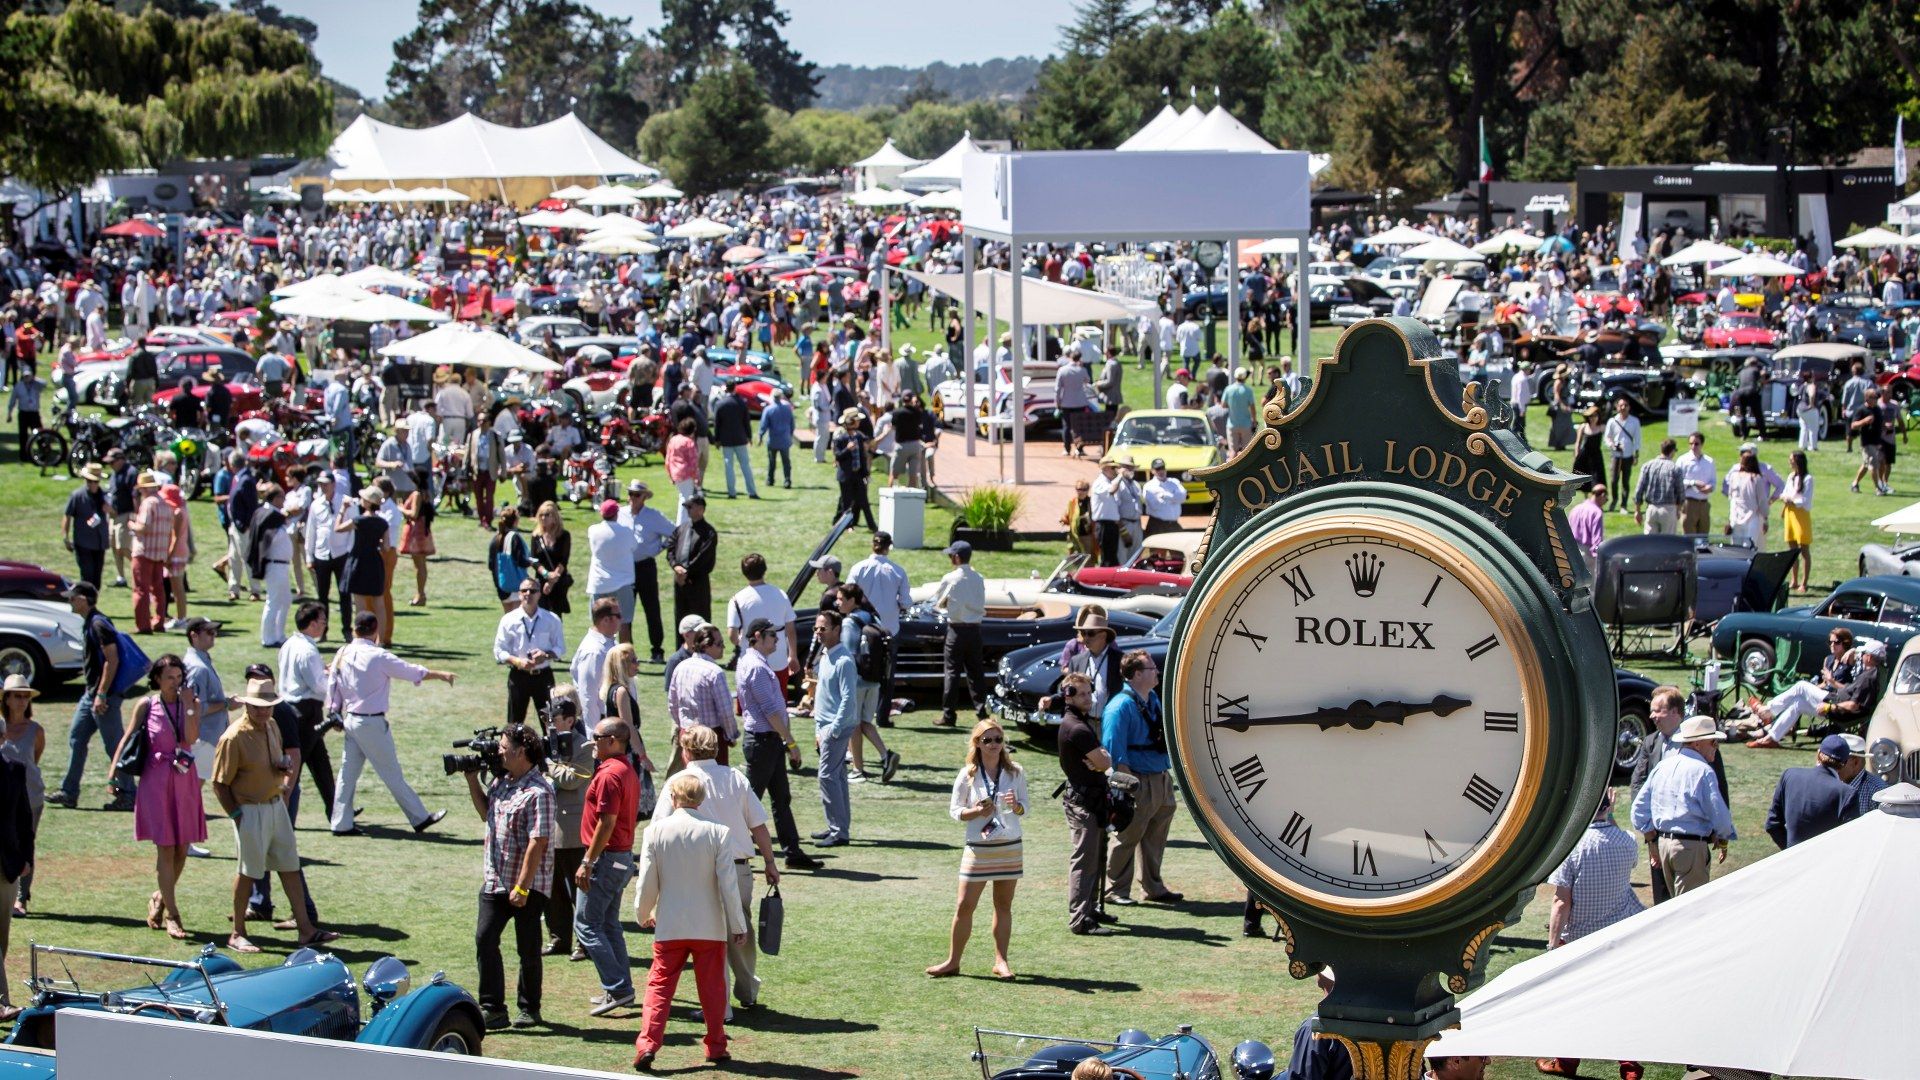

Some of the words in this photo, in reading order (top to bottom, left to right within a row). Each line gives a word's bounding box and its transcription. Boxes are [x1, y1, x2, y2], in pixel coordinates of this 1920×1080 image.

[1237, 441, 1363, 515] QUAIL
[1384, 440, 1522, 517] LODGE
[1279, 564, 1316, 607] XI
[1421, 574, 1443, 608] I
[1232, 618, 1268, 653] X
[1294, 616, 1436, 650] ROLEX
[1465, 633, 1501, 661] II
[1484, 710, 1518, 733] III
[1228, 754, 1268, 804] VIII
[1462, 773, 1504, 815] IIII
[1278, 810, 1313, 858] VII
[1424, 828, 1449, 865] V
[1352, 839, 1379, 876] VI
